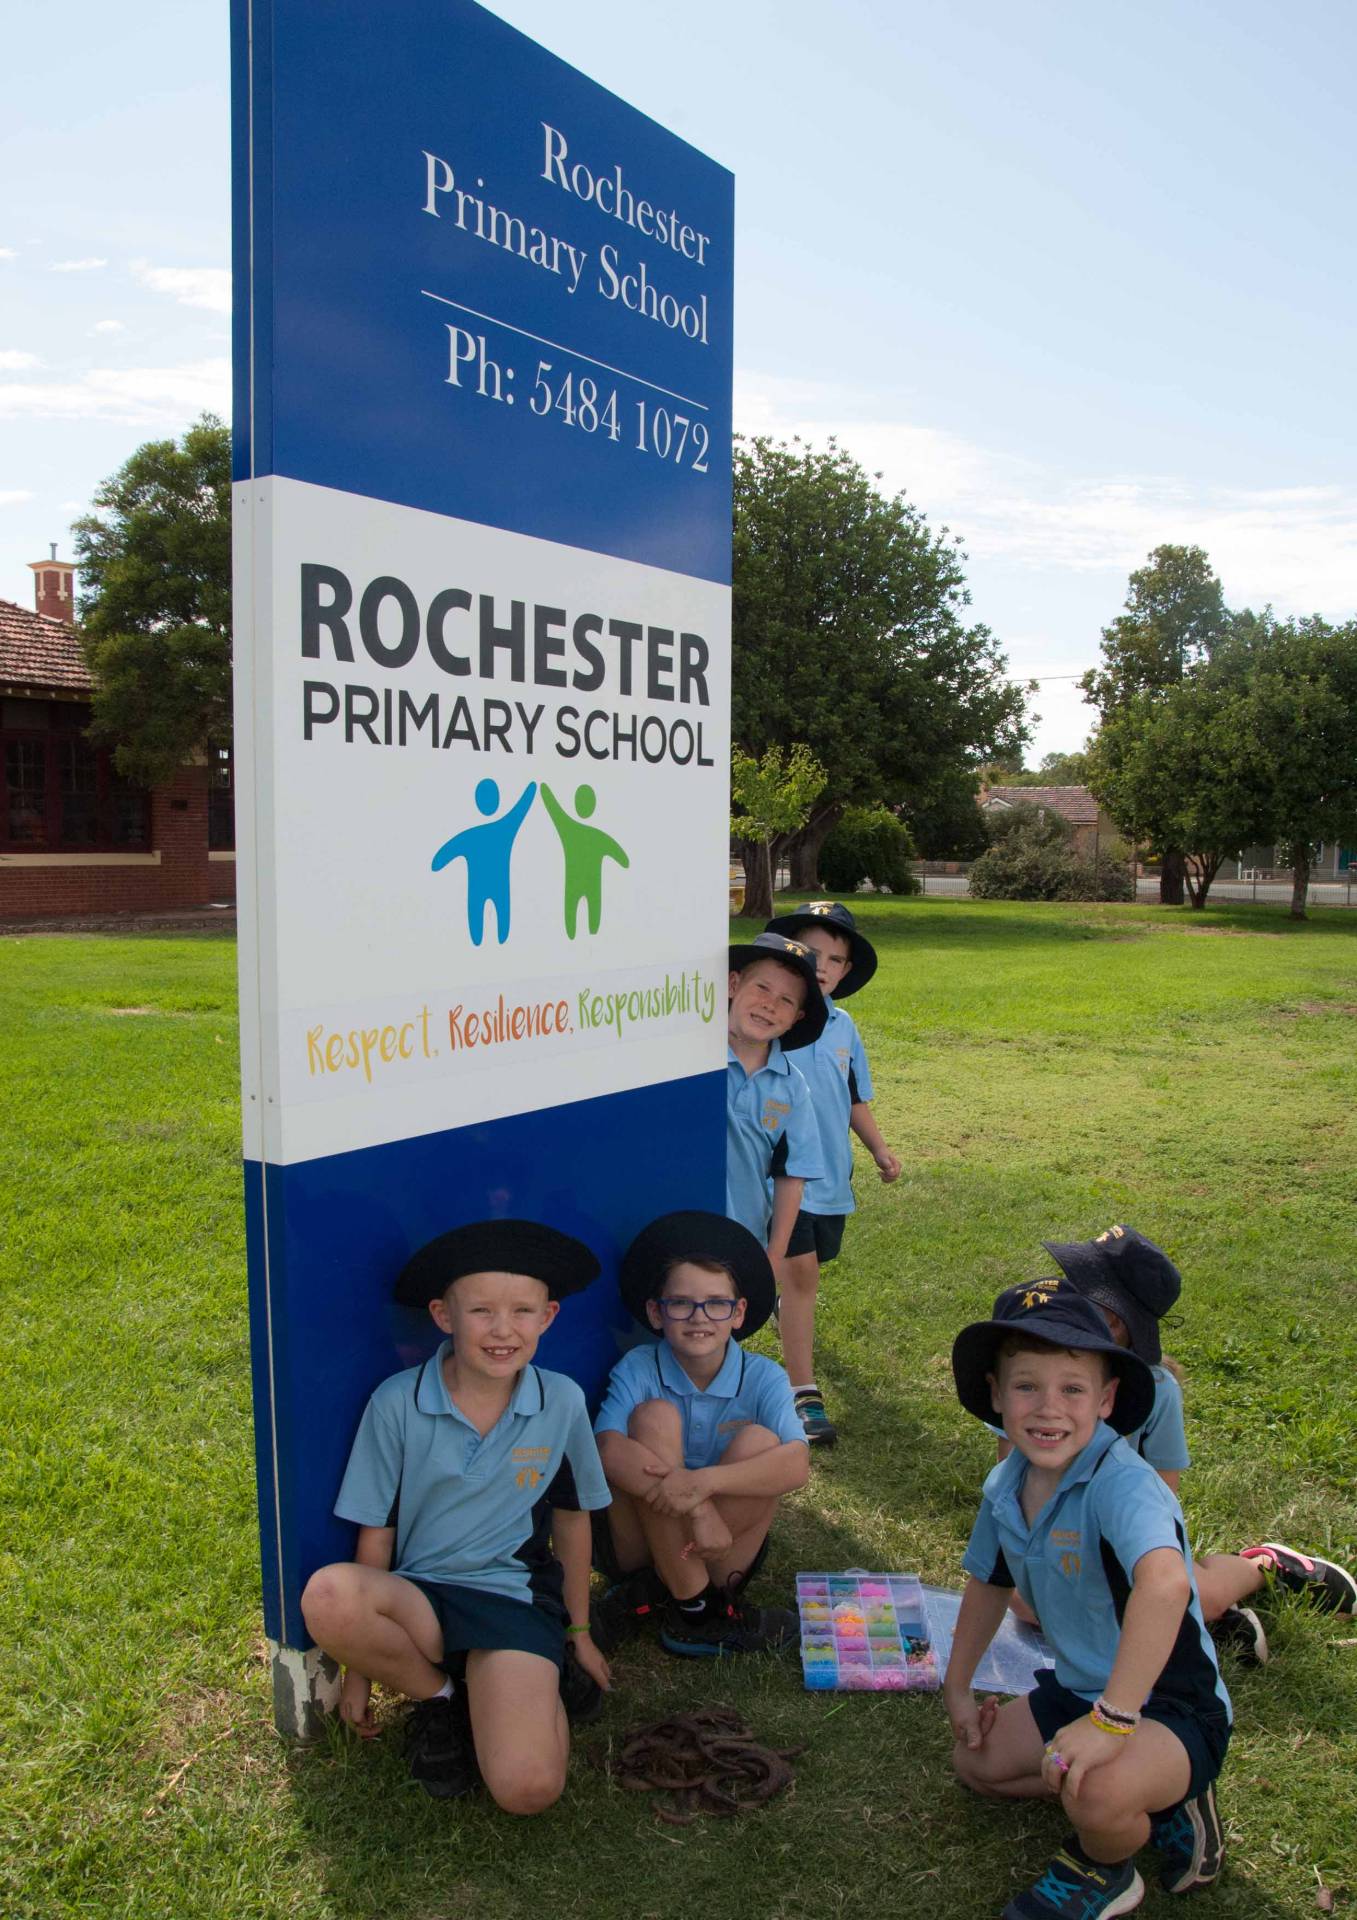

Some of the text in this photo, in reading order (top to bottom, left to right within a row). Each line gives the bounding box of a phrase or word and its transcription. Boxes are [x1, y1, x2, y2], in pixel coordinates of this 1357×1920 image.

[421, 150, 710, 346] Primary School
[540, 121, 710, 266] Rochester
[443, 323, 710, 473] Ph: 5484 1072
[301, 563, 710, 706] ROCHESTER
[303, 680, 715, 767] PRIMARY SCHOOL
[448, 994, 575, 1051] Resilience,
[578, 969, 717, 1038] Responsibility
